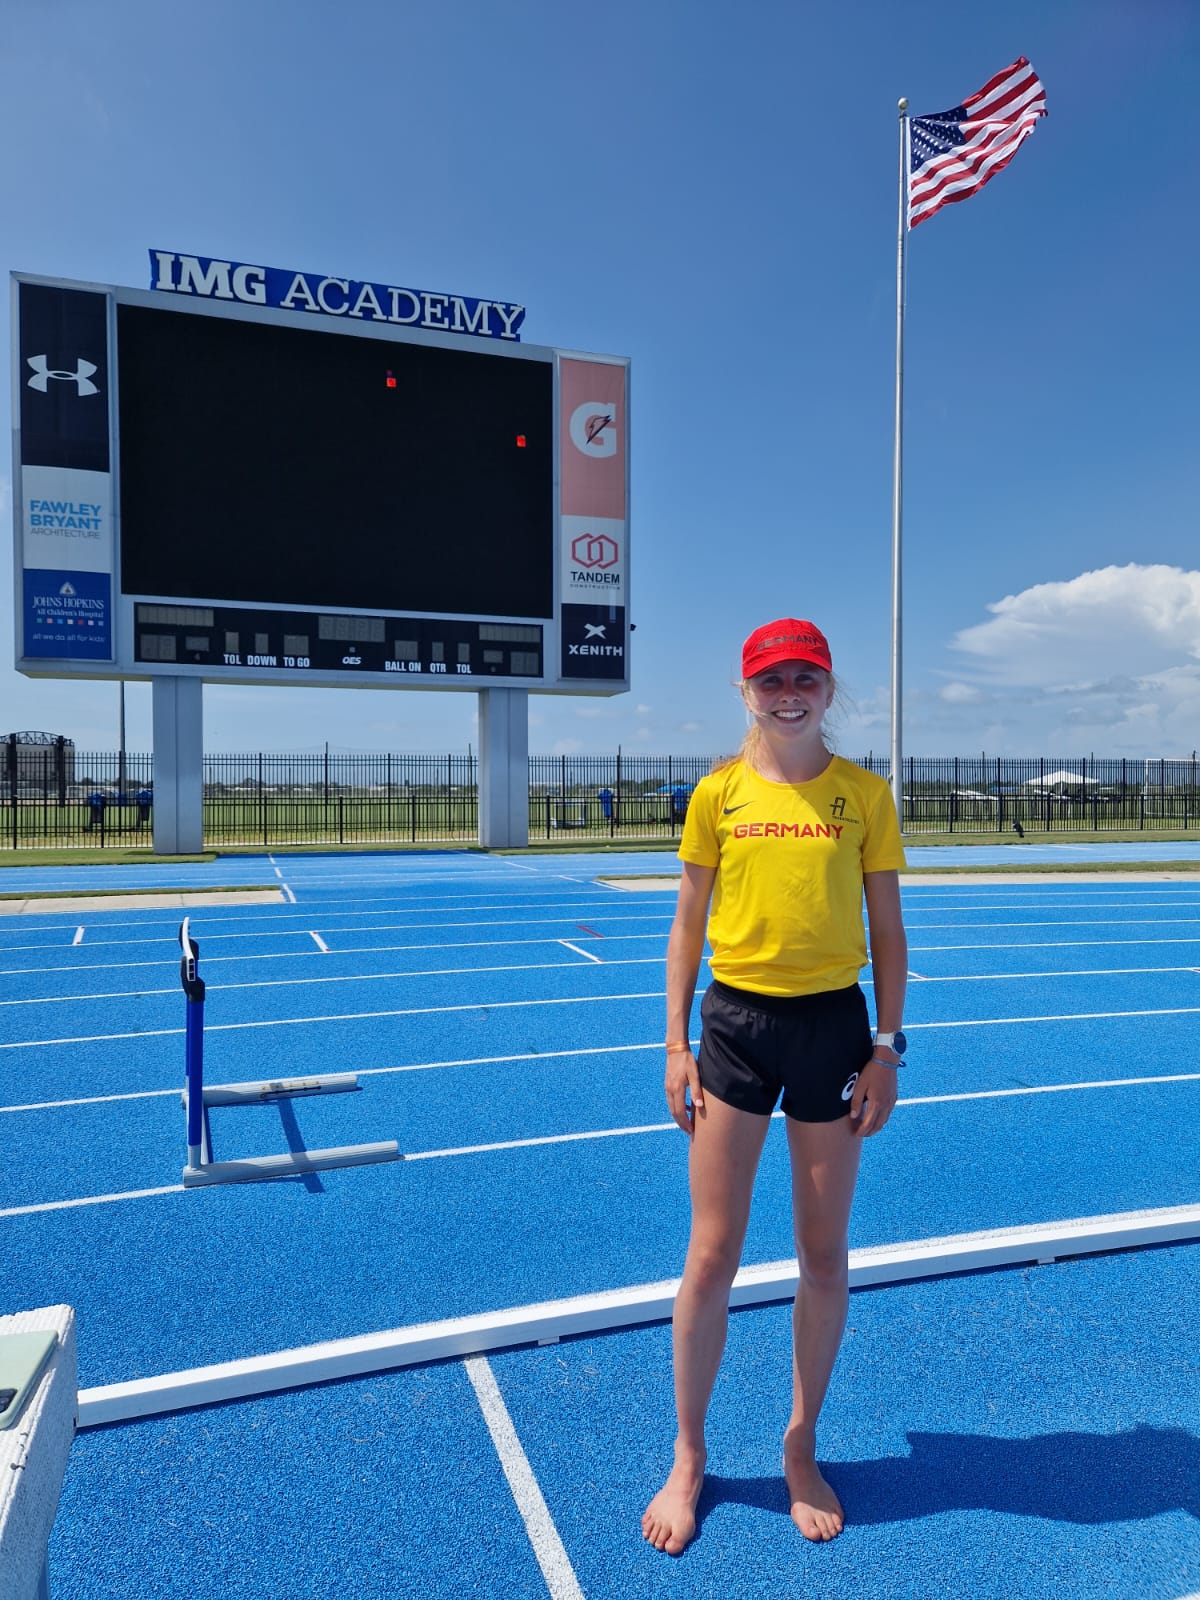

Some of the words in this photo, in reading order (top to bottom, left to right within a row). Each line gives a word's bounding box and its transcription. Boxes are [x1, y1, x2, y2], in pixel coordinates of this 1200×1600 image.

[155, 252, 266, 304] IMG
[280, 274, 524, 338] ACADEMY
[30, 500, 101, 517] FAWLEY
[30, 514, 102, 530] BRYANT
[30, 527, 101, 540] ARCHITECTURE
[570, 571, 620, 584] TANDEM
[32, 596, 62, 608] JOHNS
[63, 597, 104, 609] HOPKINS
[78, 610, 104, 618] Hospital
[757, 634, 818, 650] GERMANY
[568, 644, 623, 657] XENITH
[223, 654, 242, 665] TOL
[247, 655, 277, 666] DOWN
[283, 656, 295, 667] TO
[297, 657, 310, 667] GO
[385, 661, 406, 672] BALL
[408, 662, 422, 672] ON
[430, 663, 446, 674] QTR
[456, 664, 472, 674] TOL
[733, 822, 844, 840] GERMANY
